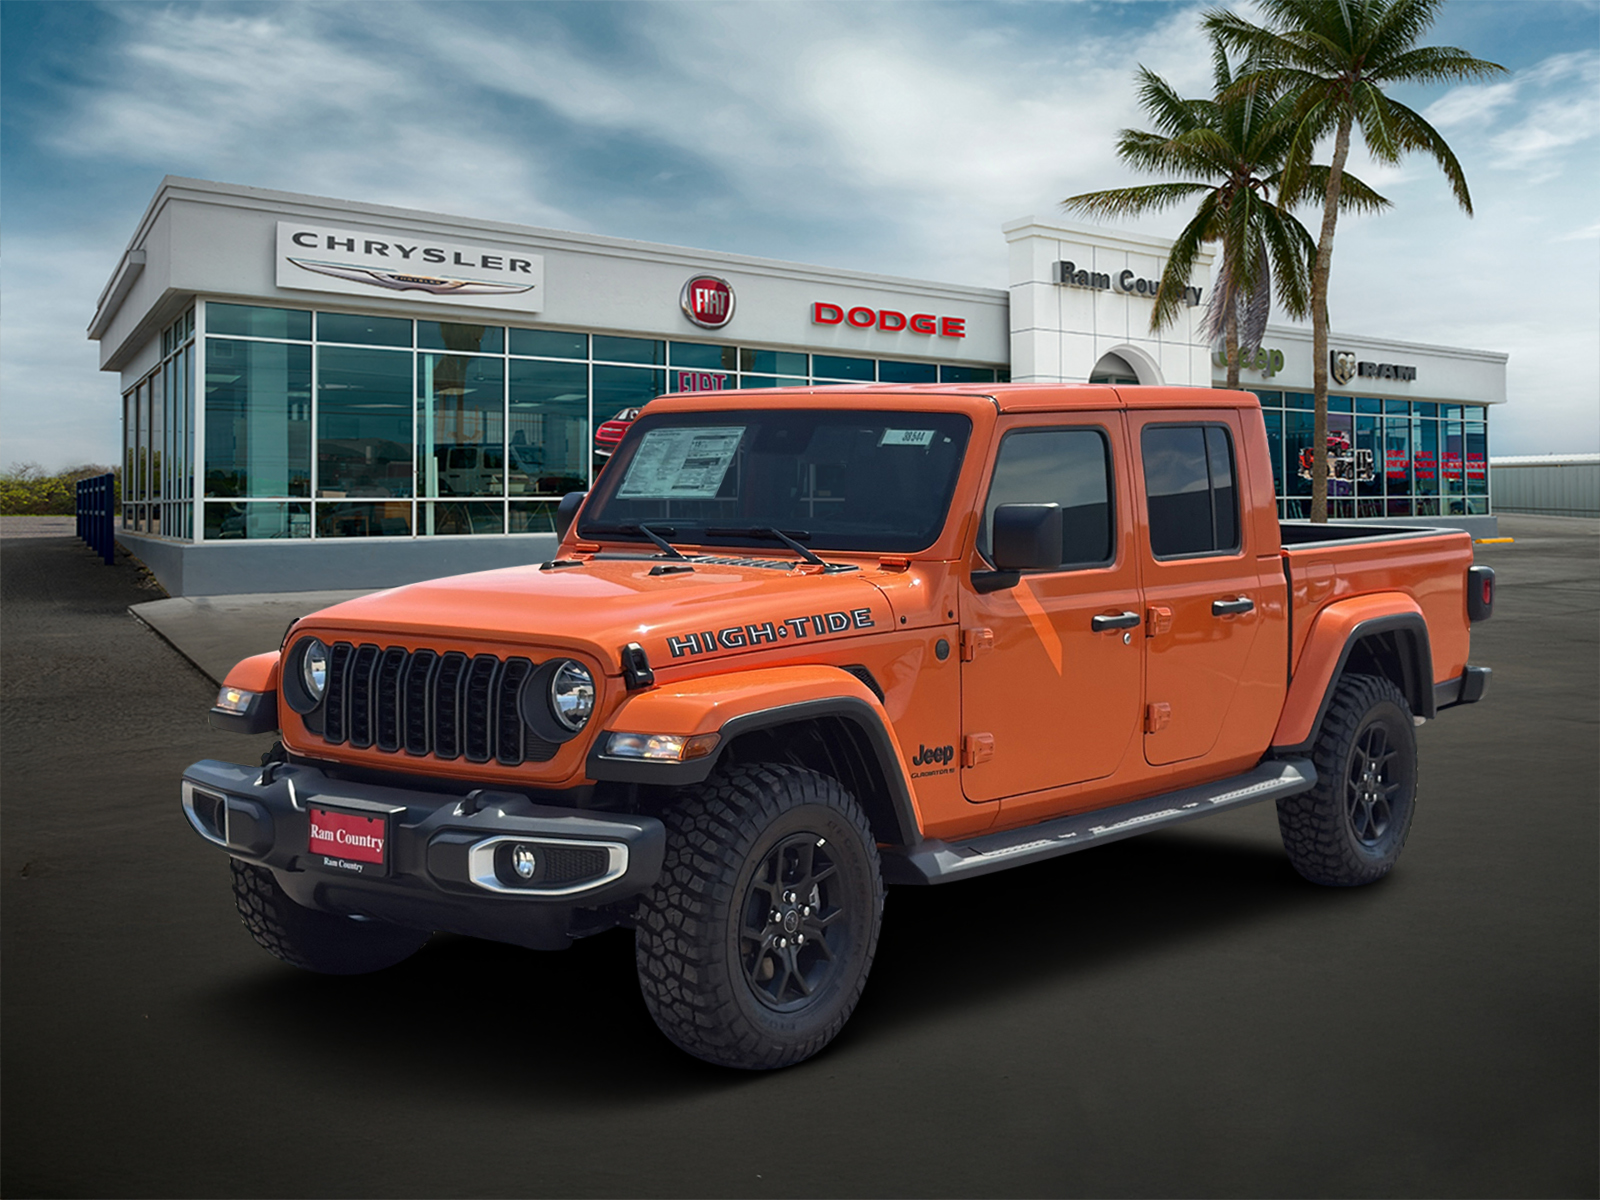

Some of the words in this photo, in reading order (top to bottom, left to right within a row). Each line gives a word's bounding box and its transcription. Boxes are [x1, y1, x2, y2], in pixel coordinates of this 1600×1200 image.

[291, 231, 532, 274] CHRYSLER
[1059, 260, 1110, 290] Ram
[1119, 269, 1202, 306] Coury
[695, 288, 727, 316] FIAT
[813, 302, 967, 339] DODGE
[678, 371, 727, 392] FIAT
[1357, 361, 1417, 382] RAM
[912, 744, 954, 766] Jeep
[310, 824, 334, 841] Ram
[336, 829, 384, 852] Country
[324, 857, 338, 867] Ram
[338, 859, 363, 873] Country
